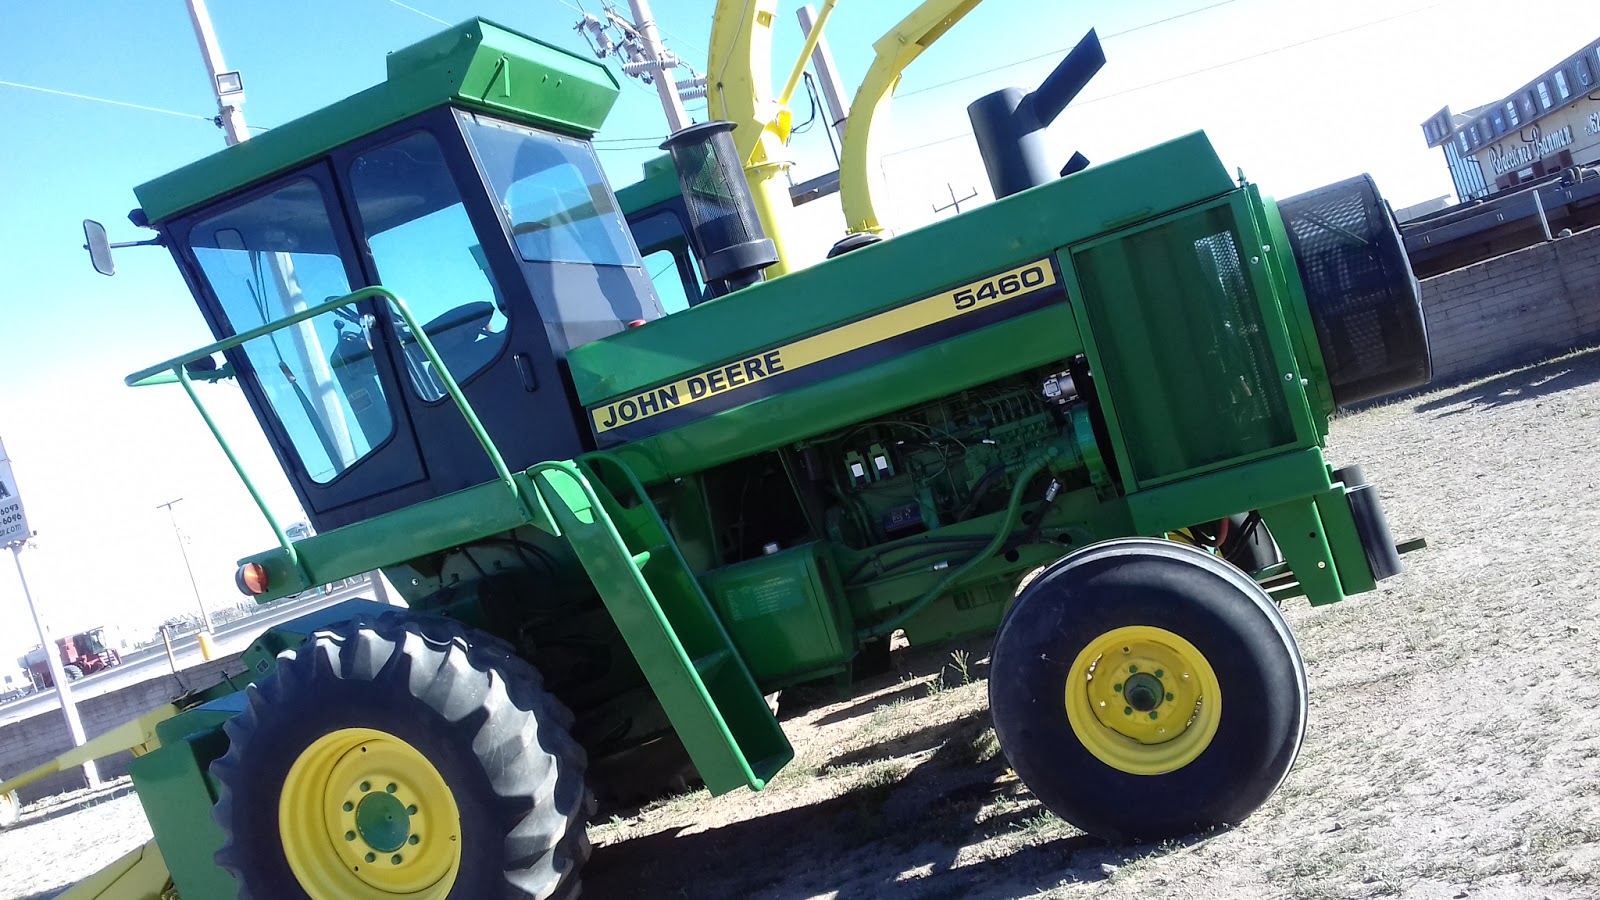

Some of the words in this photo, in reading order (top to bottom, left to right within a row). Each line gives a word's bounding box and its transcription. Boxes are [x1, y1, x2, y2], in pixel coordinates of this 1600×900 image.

[952, 266, 1045, 311] 5460
[602, 385, 681, 428] JOHN
[686, 350, 785, 401] DEERE
